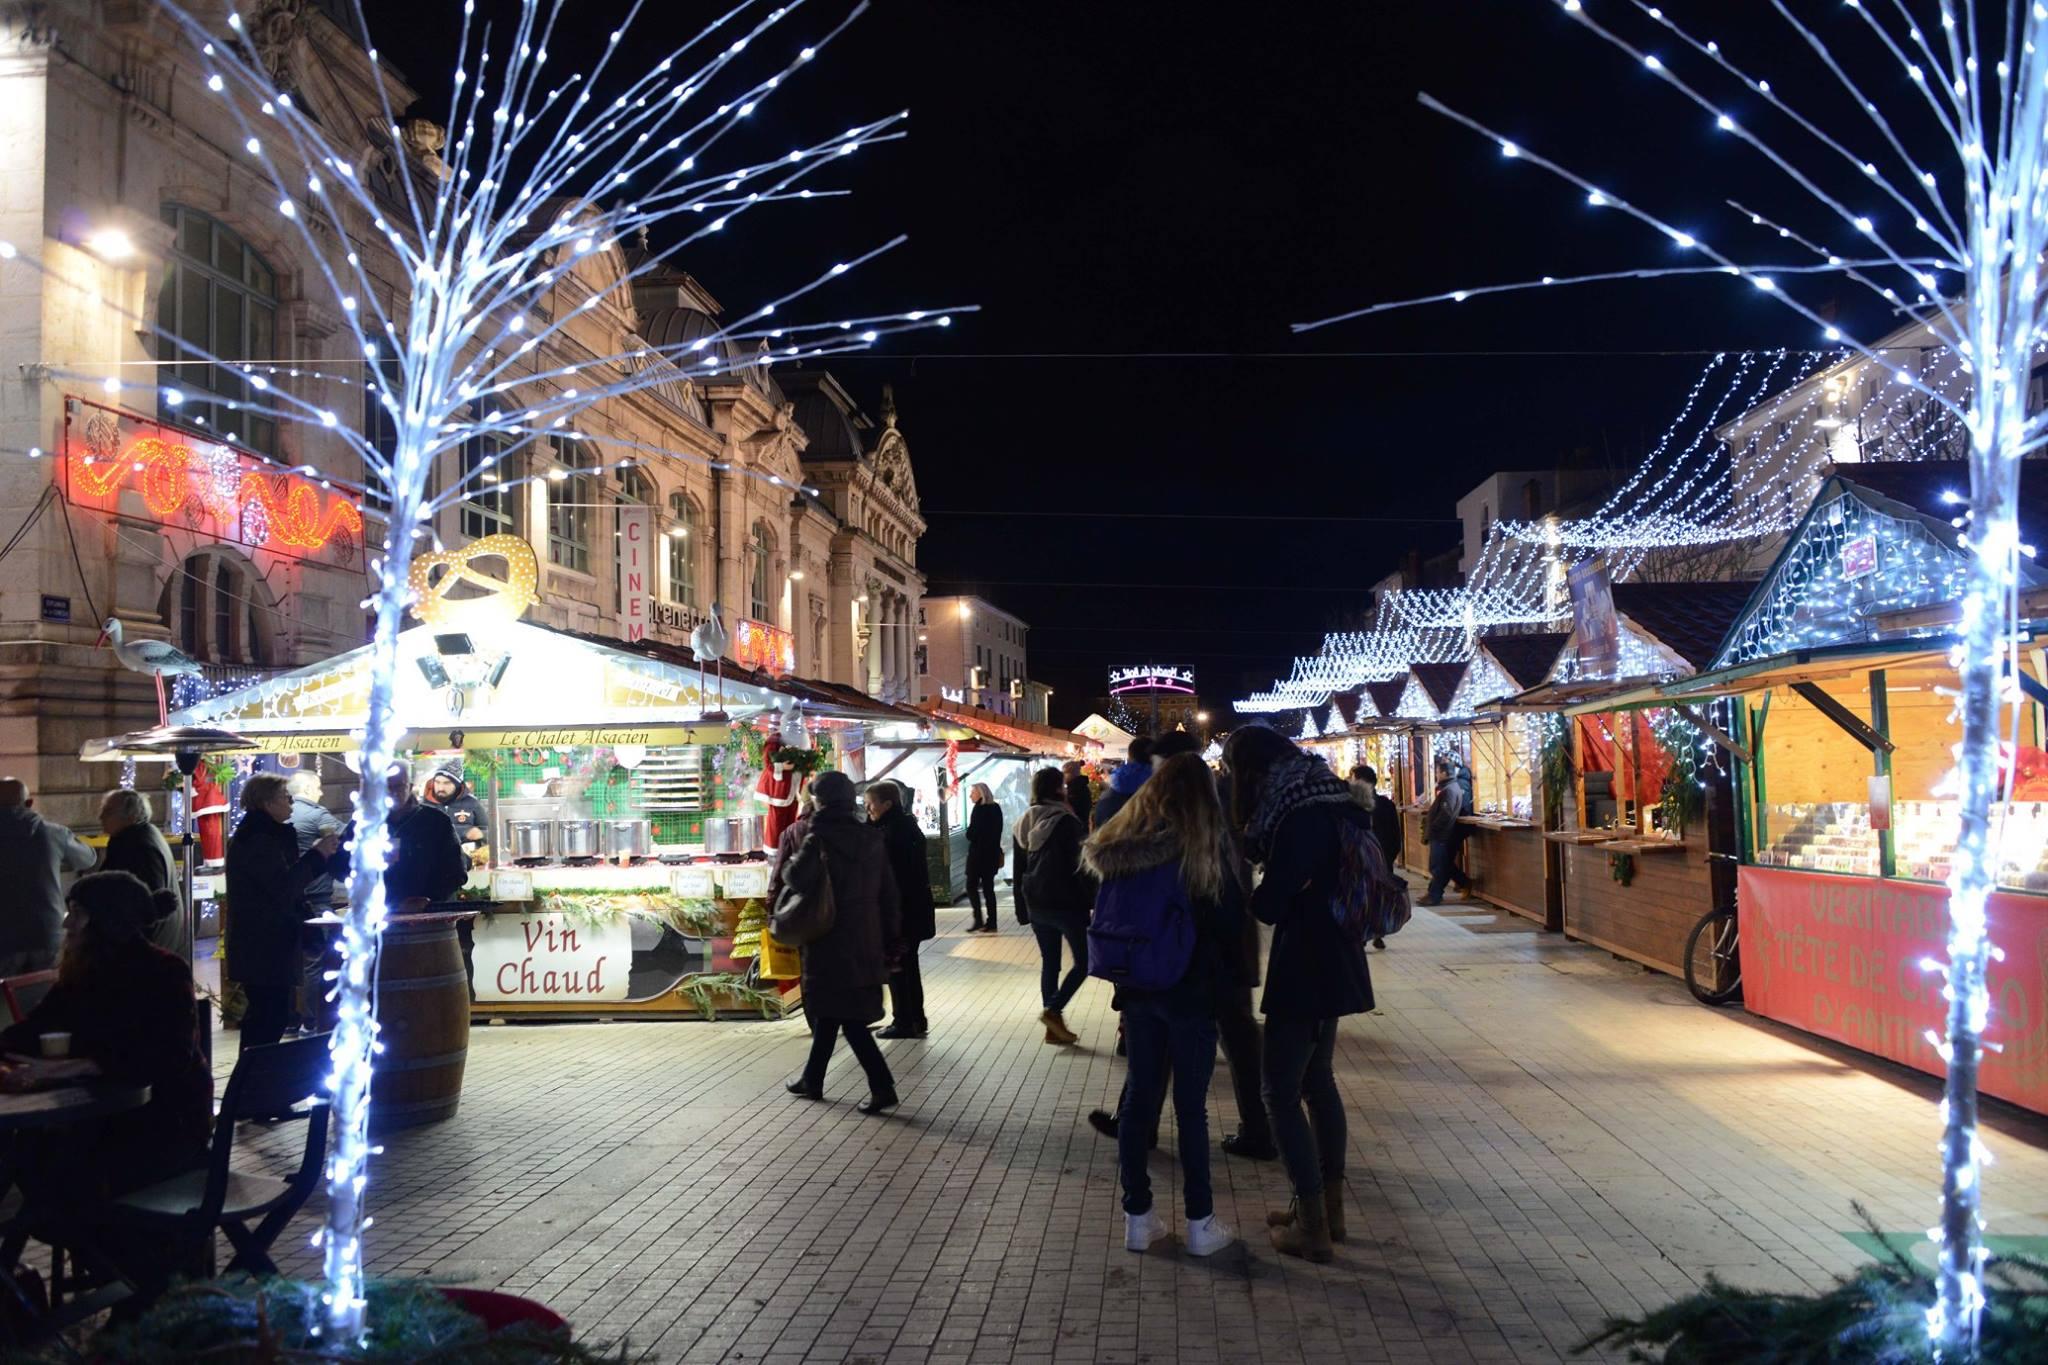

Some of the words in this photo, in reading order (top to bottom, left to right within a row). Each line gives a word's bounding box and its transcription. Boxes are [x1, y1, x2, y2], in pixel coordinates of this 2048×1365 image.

[628, 522, 643, 641] CINEM
[272, 734, 341, 752] Alsacien
[499, 731, 520, 746] Le
[525, 729, 576, 747] Chalet
[580, 728, 649, 745] Alsacien
[1809, 881, 1950, 940] VERITAB
[521, 919, 581, 953] Vin
[496, 955, 607, 995] Chaud
[1776, 923, 1840, 983] TÊTE
[1852, 944, 1888, 993] DE
